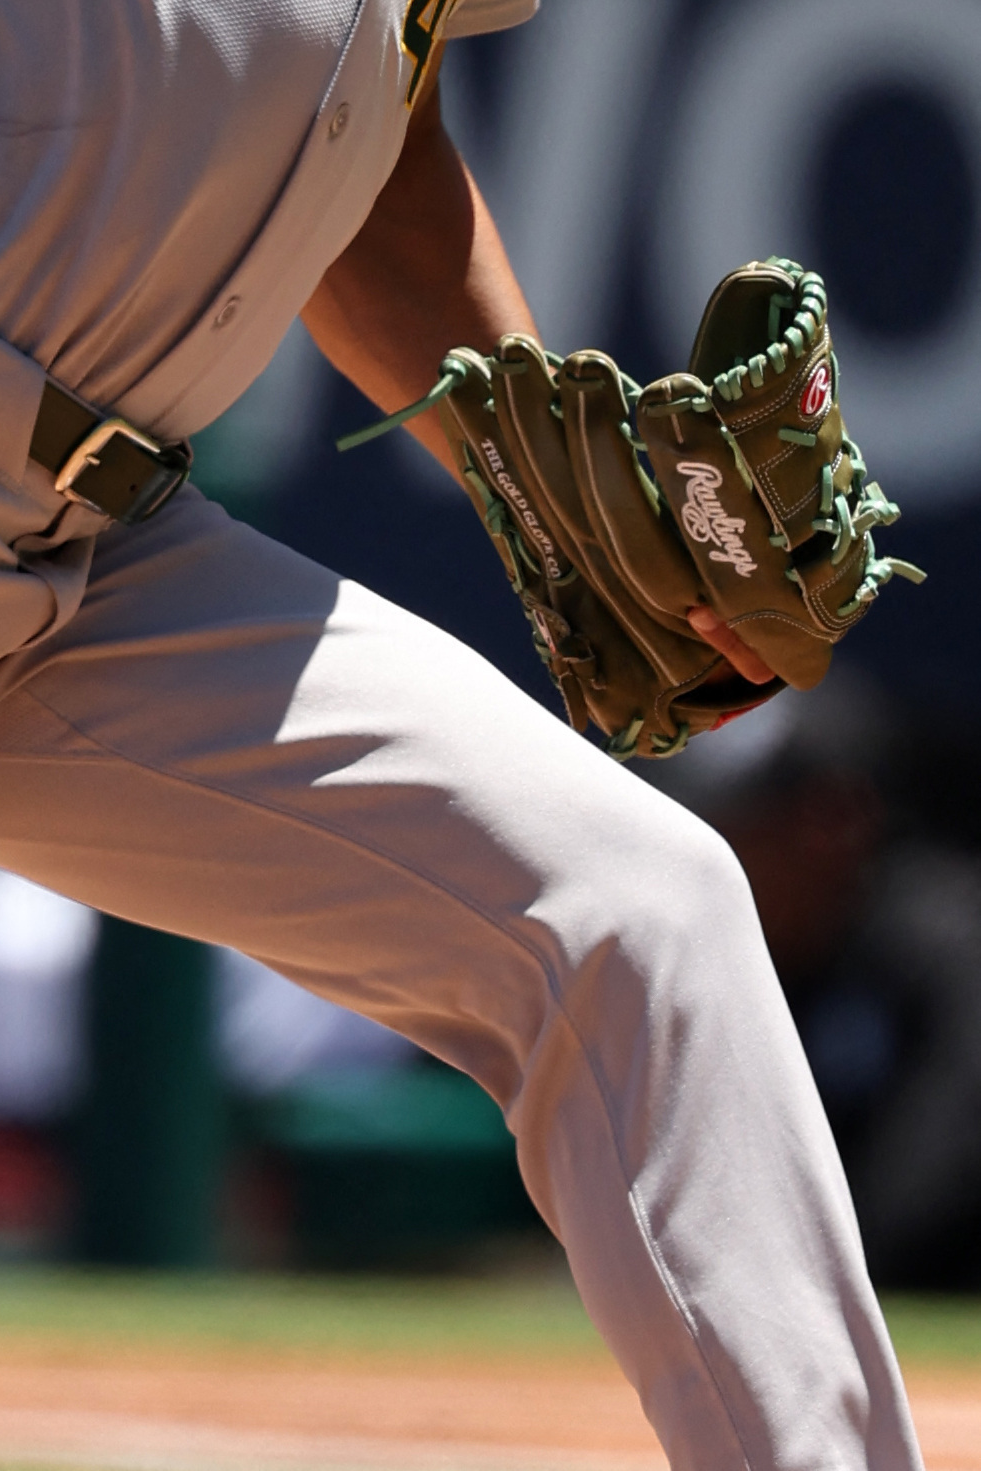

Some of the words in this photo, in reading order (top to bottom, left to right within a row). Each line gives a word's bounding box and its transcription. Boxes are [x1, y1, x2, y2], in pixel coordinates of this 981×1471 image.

[481, 437, 505, 473] THE
[497, 471, 528, 511] GOLD
[522, 510, 554, 555] GLOVE
[676, 461, 758, 578] Rawlings
